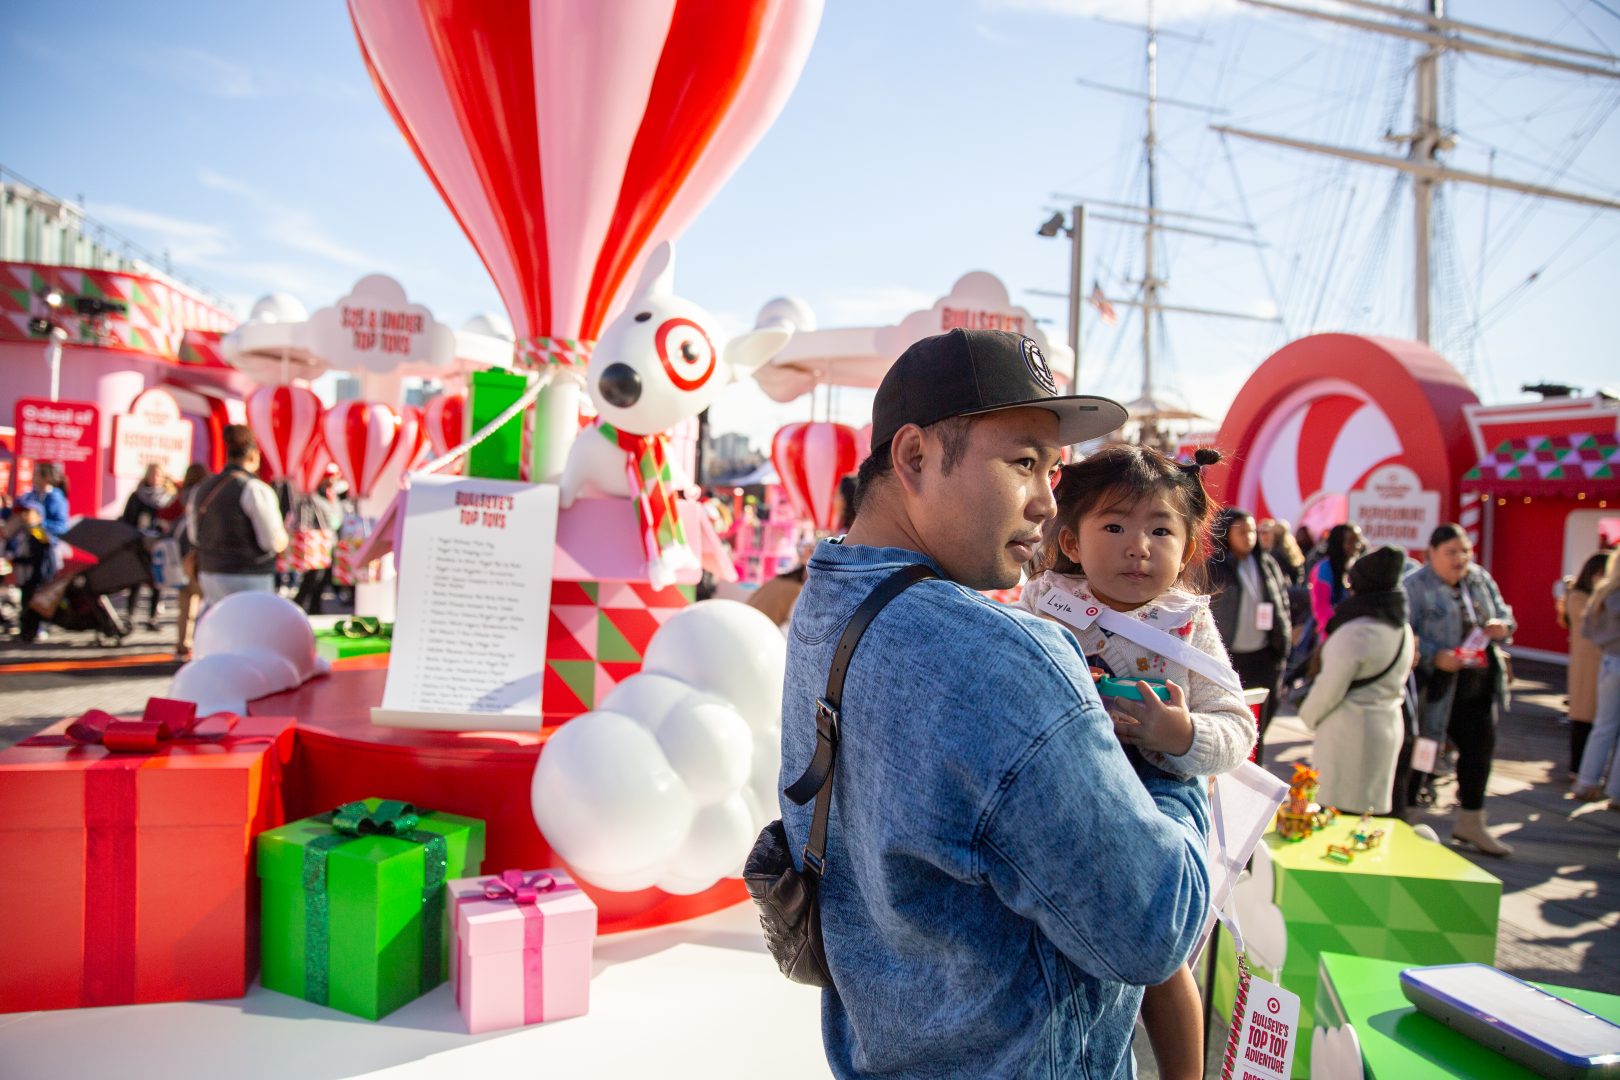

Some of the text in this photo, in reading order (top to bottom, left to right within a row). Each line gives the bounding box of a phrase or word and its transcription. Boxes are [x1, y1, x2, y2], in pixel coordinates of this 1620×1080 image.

[381, 308, 424, 334] UNDER
[354, 331, 410, 355] TOP TOYS
[456, 490, 513, 511] BULLSEYE'S
[460, 509, 506, 529] TOP TOYS
[1047, 594, 1072, 612] Layla
[1251, 1010, 1289, 1038] BULLSEYE'S
[1248, 1024, 1288, 1059] TOP TOY
[1244, 1046, 1285, 1074] ADVENTURE
